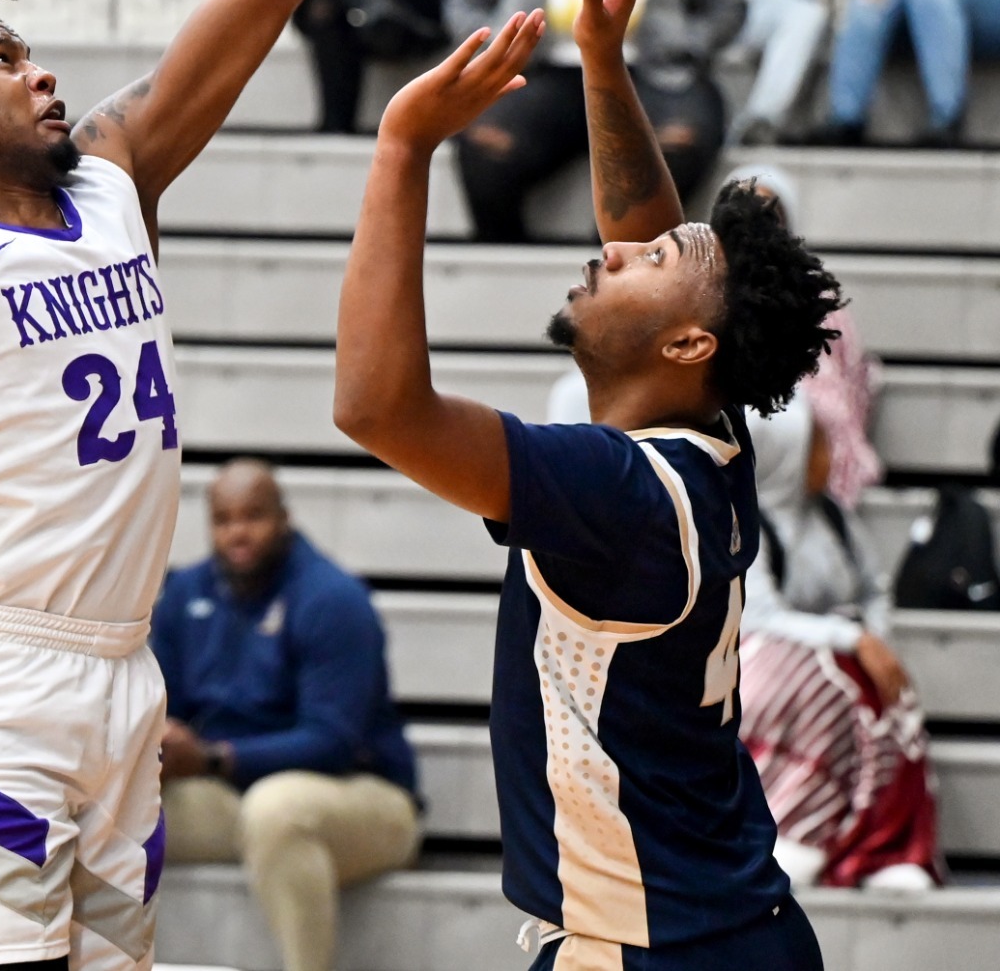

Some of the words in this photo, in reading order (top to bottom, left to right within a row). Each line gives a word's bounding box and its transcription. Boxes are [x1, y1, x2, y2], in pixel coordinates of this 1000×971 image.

[1, 253, 165, 348] KNIGHTS
[61, 340, 178, 467] 24
[700, 575, 743, 727] 4
